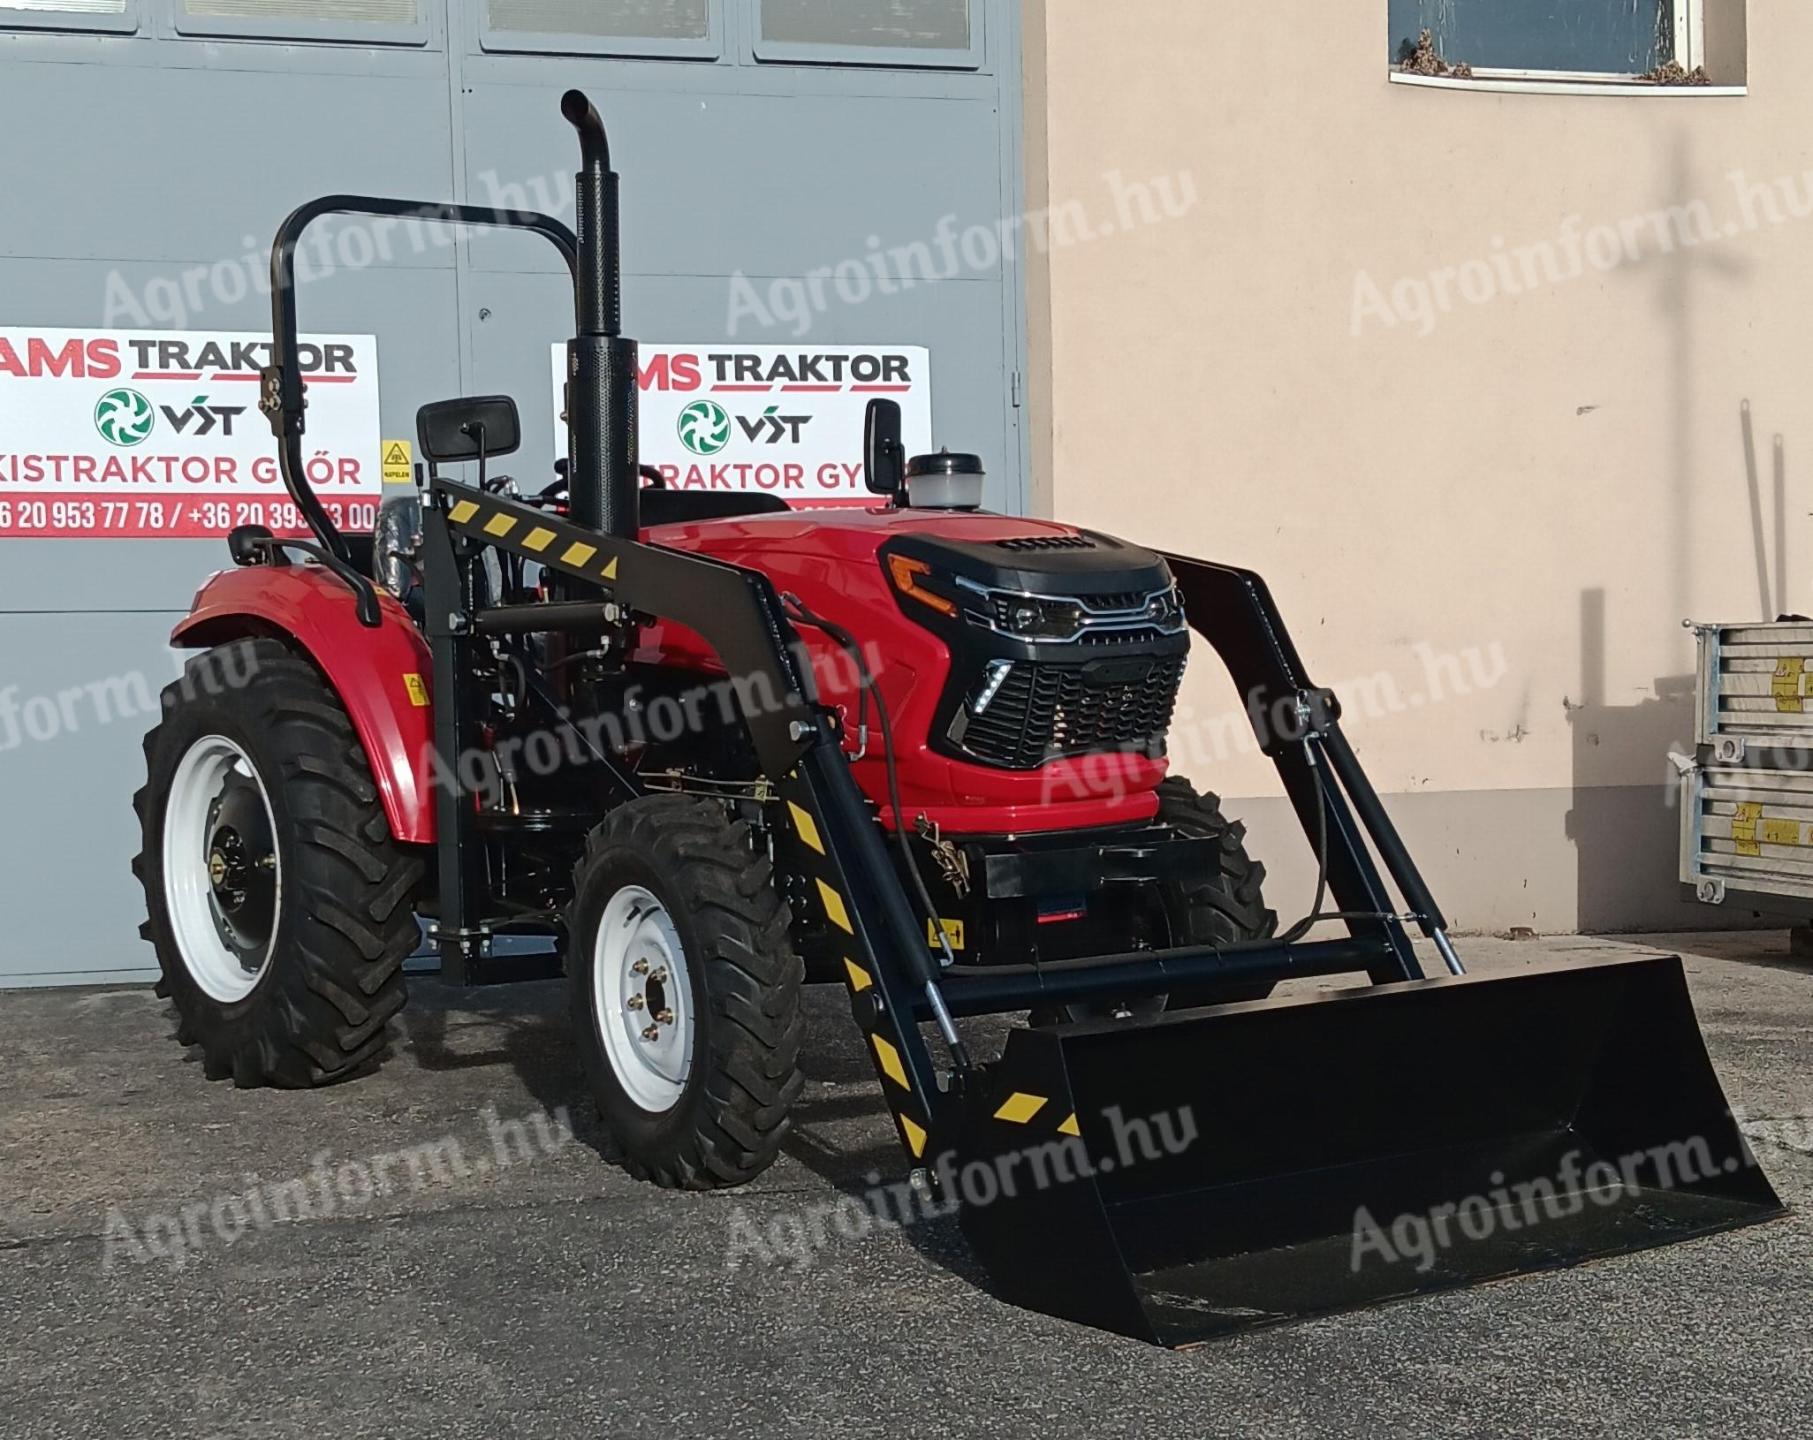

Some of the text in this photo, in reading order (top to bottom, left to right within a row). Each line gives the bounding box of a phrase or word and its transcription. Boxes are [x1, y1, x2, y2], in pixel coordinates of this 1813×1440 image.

[638, 353, 911, 391] MS TRAKTOR
[252, 451, 361, 484] GŐR
[817, 463, 862, 489] GY
[17, 501, 46, 528] 20
[52, 501, 95, 528] 953
[102, 502, 128, 528] 77
[139, 502, 164, 528] 78
[169, 502, 182, 528] /
[188, 503, 230, 528] +36
[236, 503, 264, 526] 20
[349, 503, 375, 529] 00
